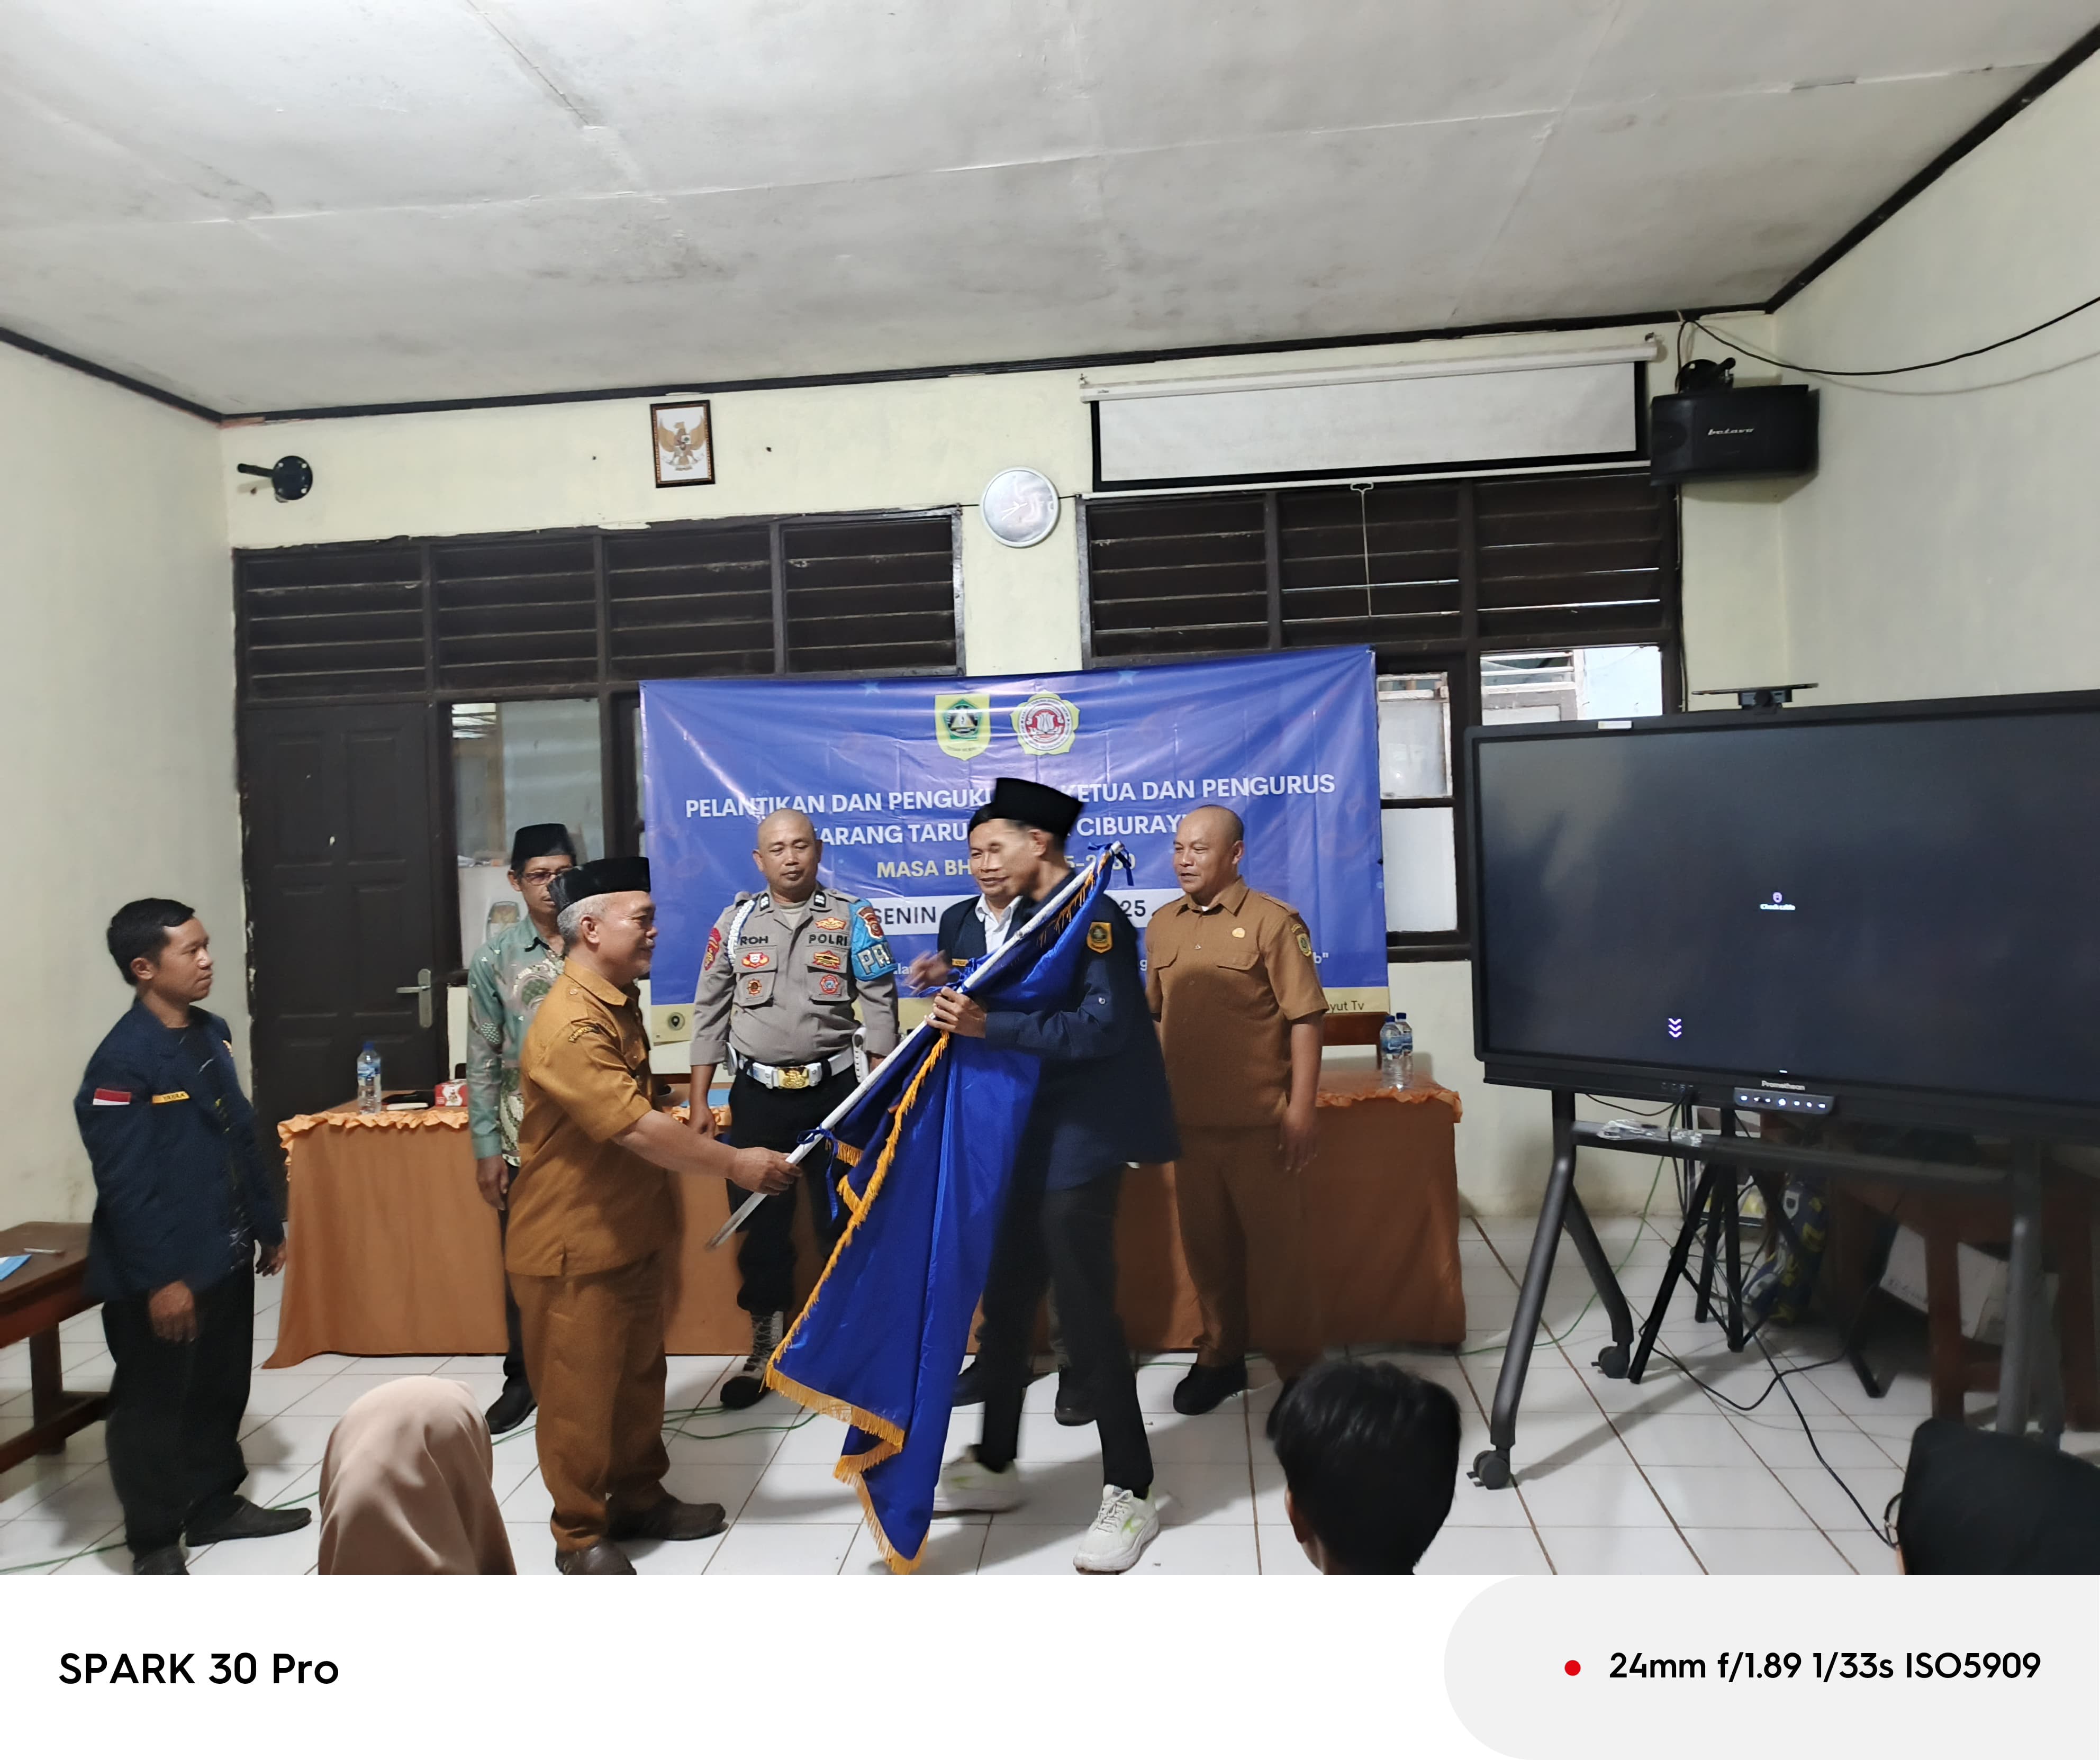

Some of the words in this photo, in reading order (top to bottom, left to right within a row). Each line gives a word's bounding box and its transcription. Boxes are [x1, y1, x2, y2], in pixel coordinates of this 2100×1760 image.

[686, 795, 825, 818] PELANTIKAN
[832, 793, 882, 813] DAN
[1143, 780, 1196, 800] DAN
[1202, 774, 1335, 797] PENGURUS
[815, 825, 903, 845] ARANG
[908, 822, 968, 843] TARU
[1076, 814, 1187, 837] CIBURAY
[877, 859, 938, 878] MASA
[945, 859, 971, 876] BH
[873, 906, 936, 925] SENIN
[1120, 900, 1146, 917] 25
[809, 934, 848, 946] POLRI
[1329, 1001, 1348, 1013] yut
[1351, 1001, 1365, 1010] Tv
